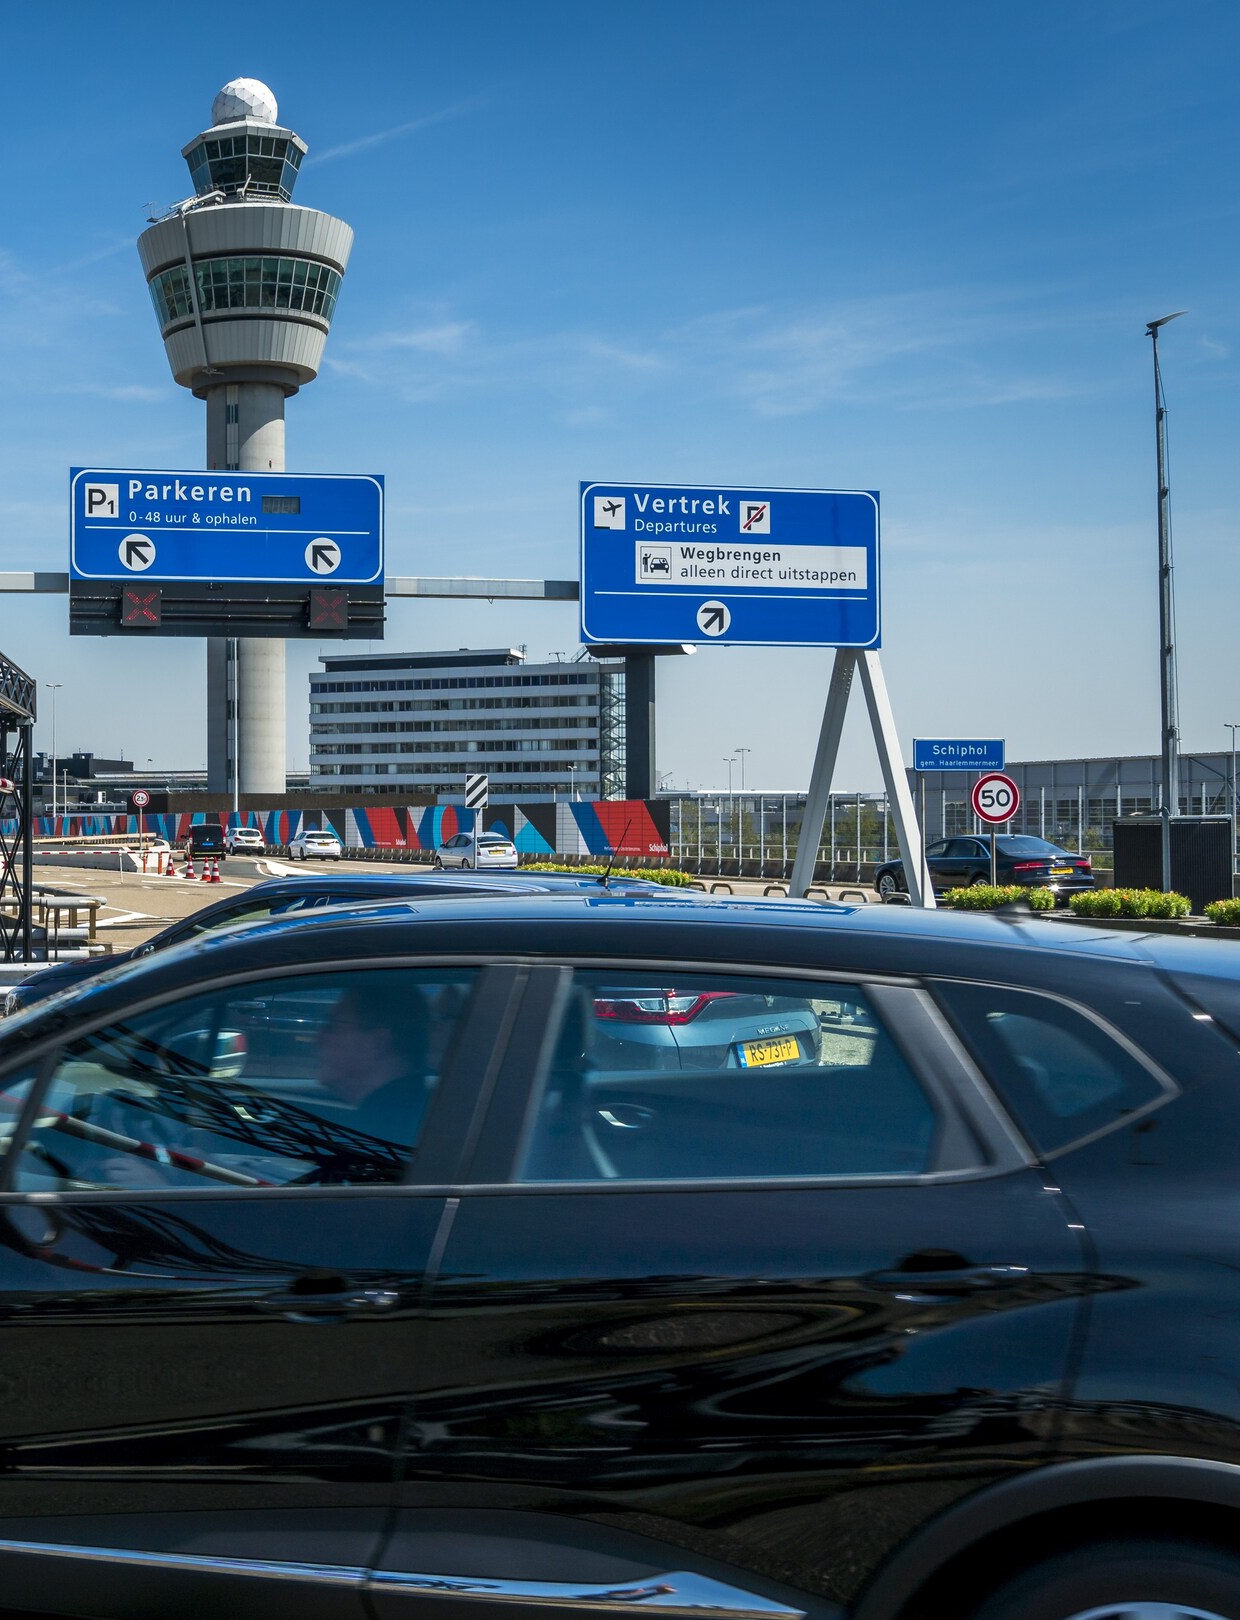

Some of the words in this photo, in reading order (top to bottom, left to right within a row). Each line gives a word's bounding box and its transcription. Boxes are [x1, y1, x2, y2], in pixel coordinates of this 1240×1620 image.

[129, 480, 251, 502] Parkeren
[87, 488, 115, 515] P1
[633, 493, 731, 516] Vertrek
[128, 510, 161, 524] 0-48
[165, 513, 187, 524] uur
[192, 512, 201, 524] &
[205, 513, 258, 528] ophalen
[634, 519, 718, 535] Departures
[680, 546, 782, 563] Wegbrengen
[680, 565, 726, 579] alleen
[730, 566, 774, 580] direct
[778, 567, 858, 584] uitstappen
[932, 745, 987, 756] Schiphol
[981, 789, 1010, 808] 50
[749, 1039, 791, 1062] RS-731-P
